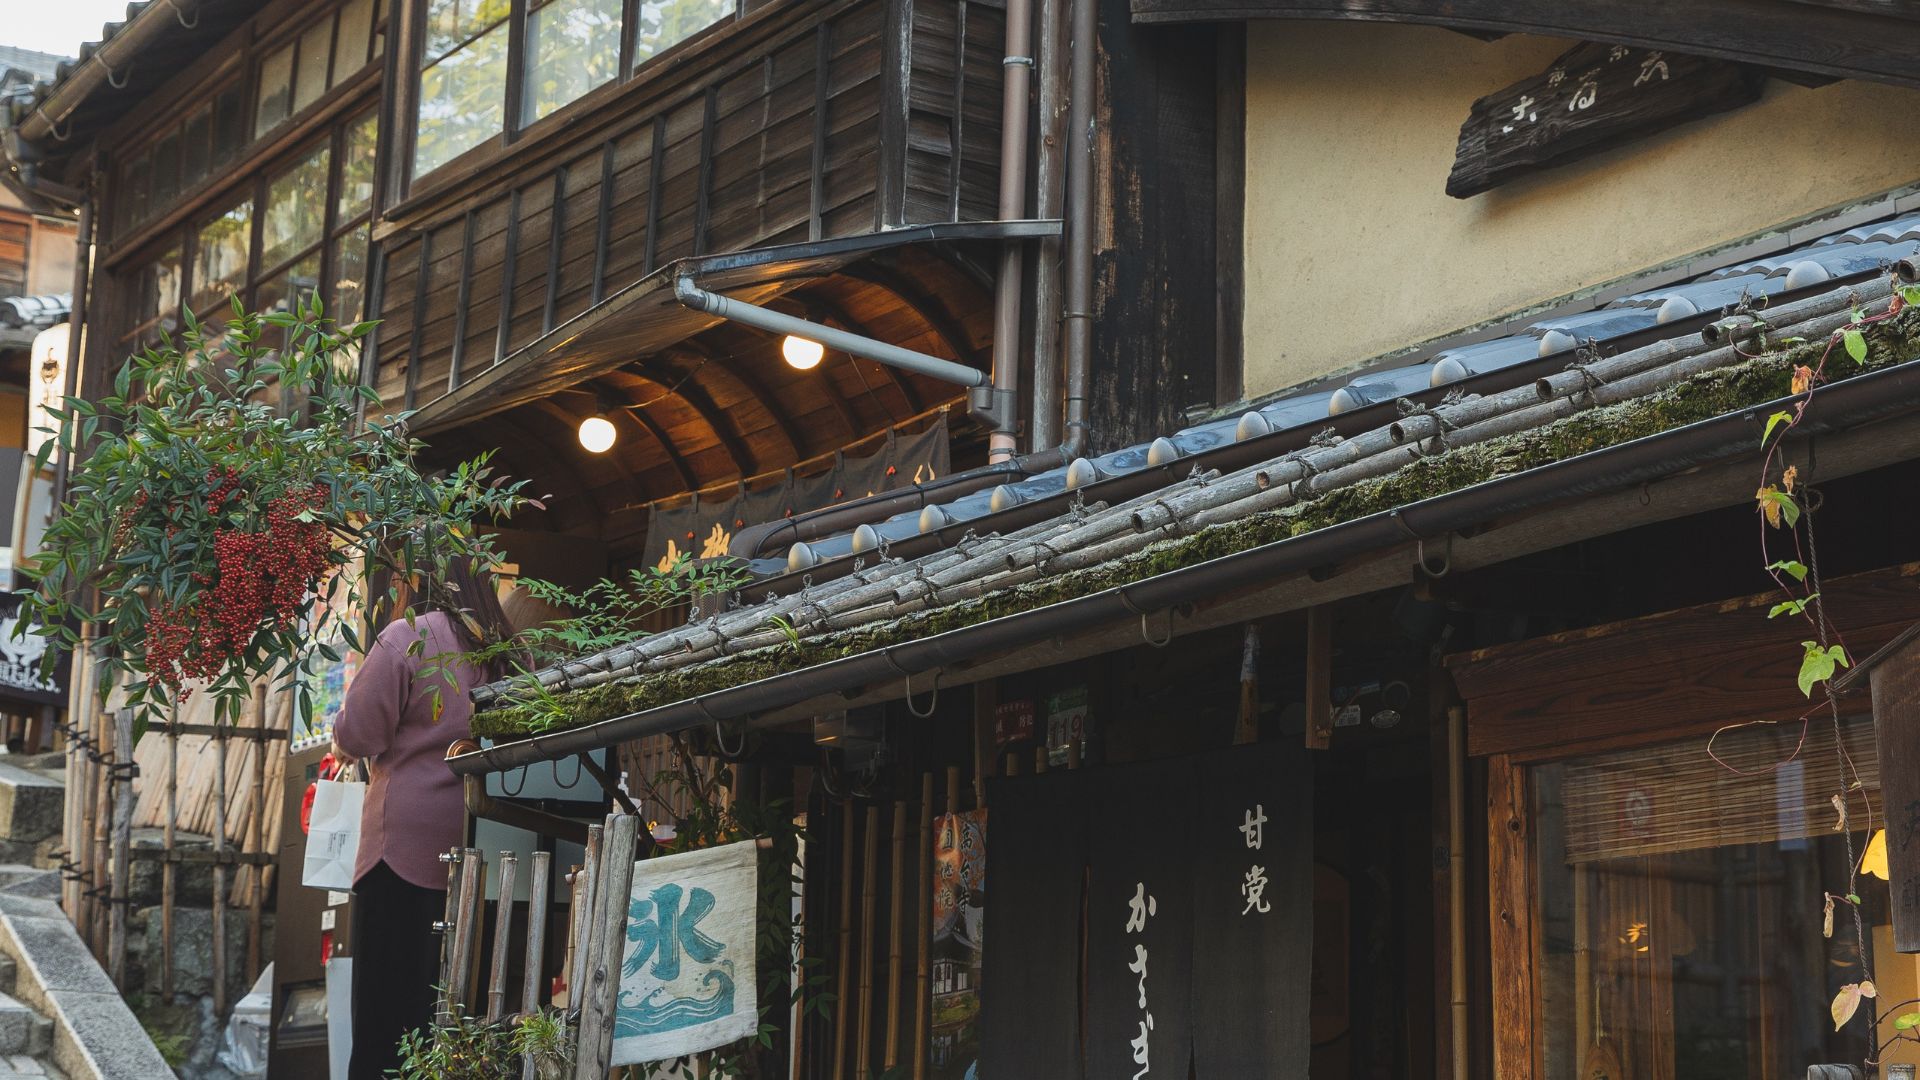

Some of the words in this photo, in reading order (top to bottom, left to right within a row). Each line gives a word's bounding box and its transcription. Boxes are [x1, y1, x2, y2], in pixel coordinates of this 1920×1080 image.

[957, 824, 974, 915] 高台寺
[1238, 804, 1271, 916] 甘党
[622, 882, 727, 981] 氷
